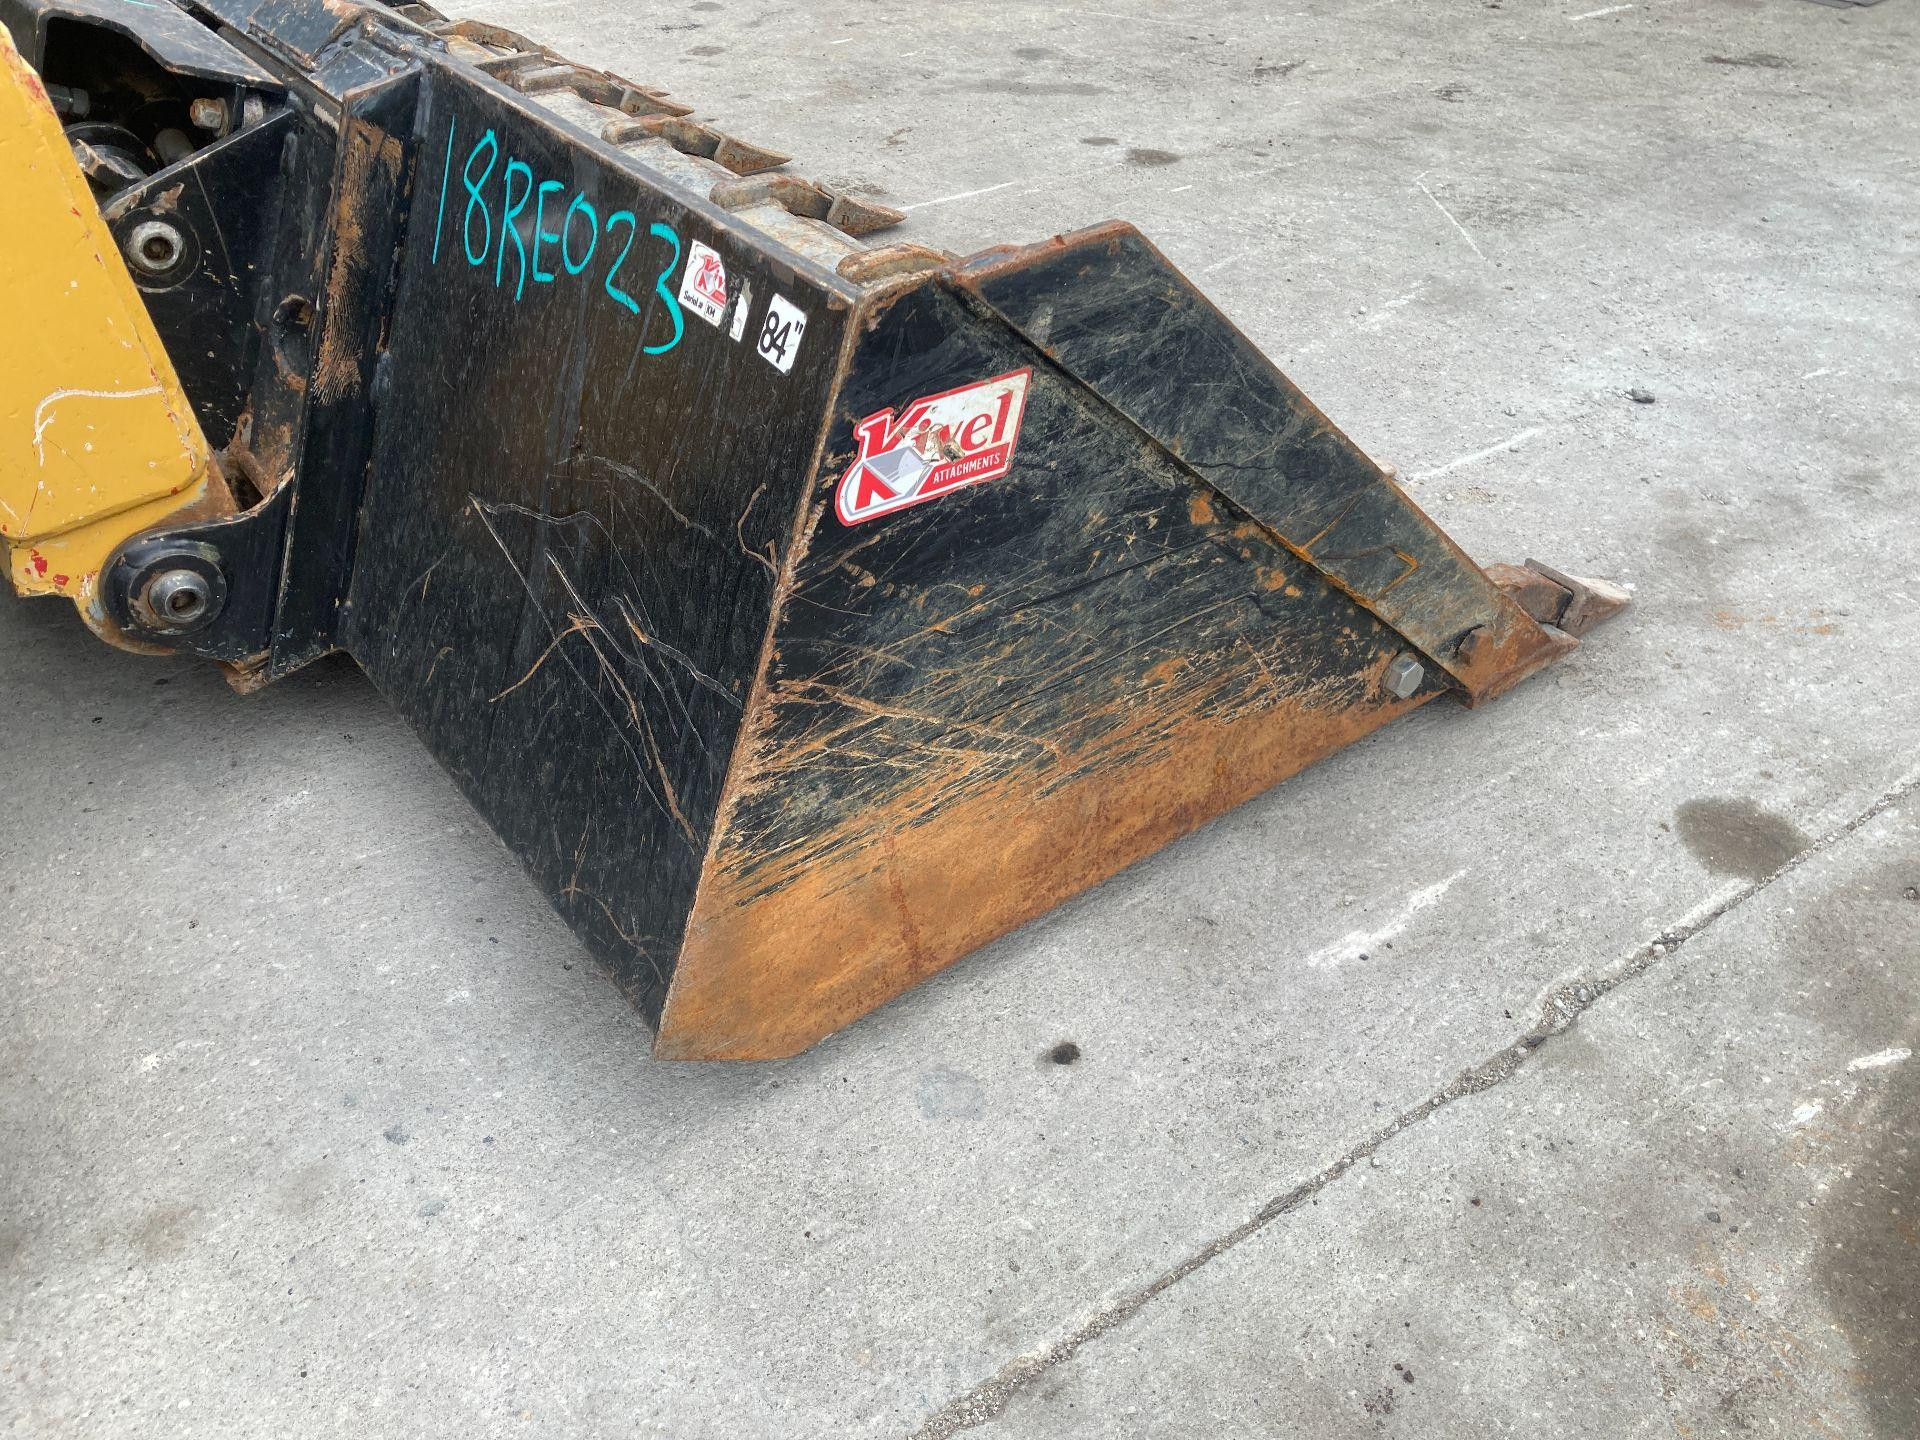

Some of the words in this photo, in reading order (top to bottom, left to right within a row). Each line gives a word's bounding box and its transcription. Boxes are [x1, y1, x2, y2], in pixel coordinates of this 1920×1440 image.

[684, 290, 699, 307] Serial
[760, 310, 804, 364] 84"
[933, 452, 1001, 484] ATTACHMENTS
